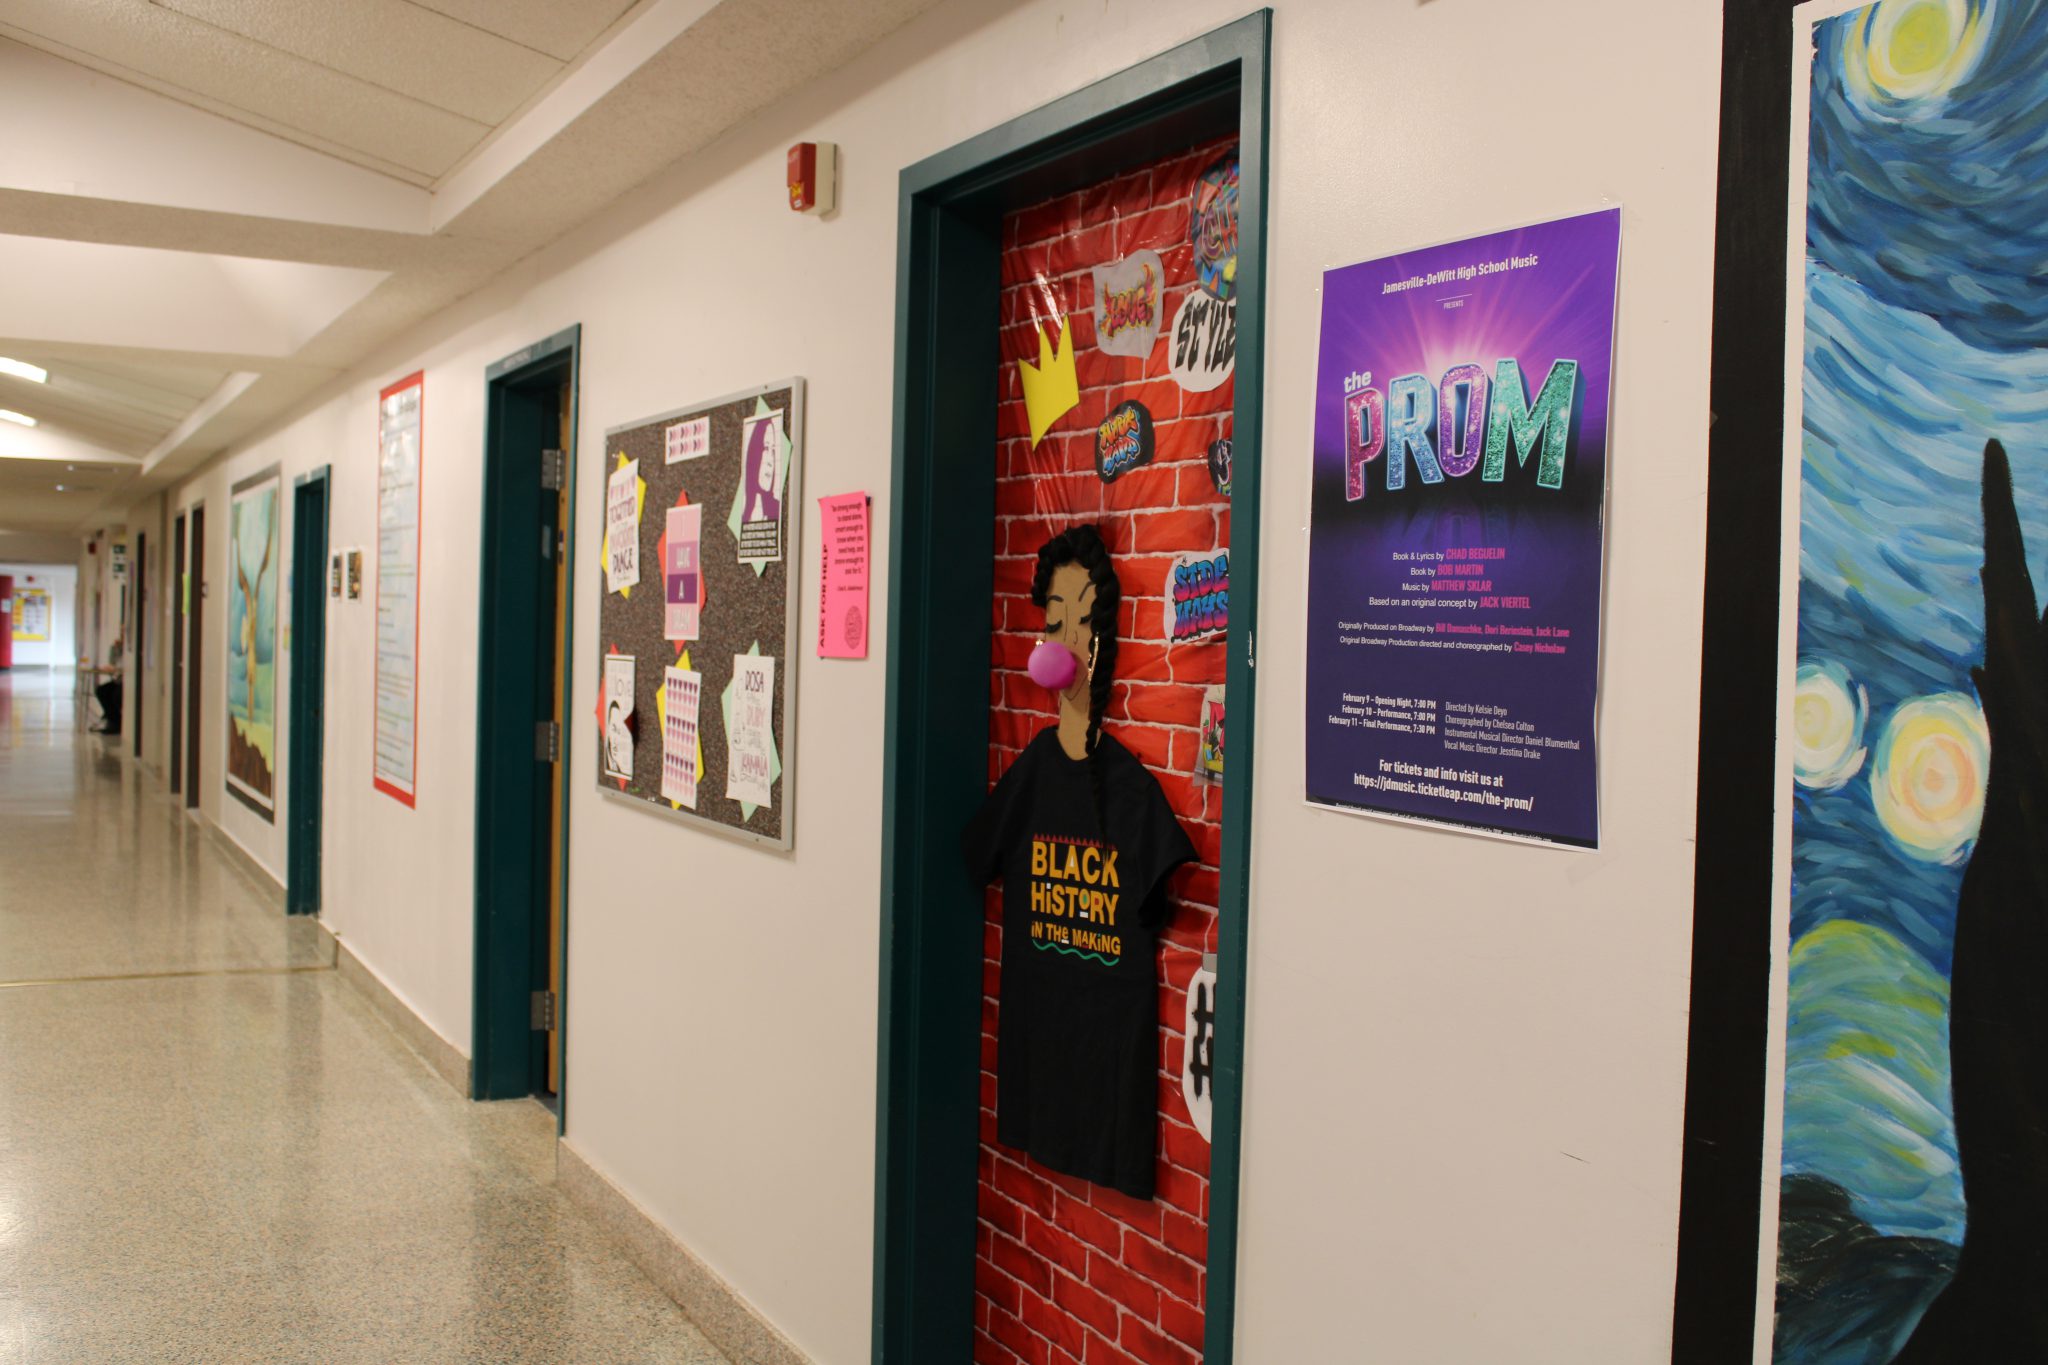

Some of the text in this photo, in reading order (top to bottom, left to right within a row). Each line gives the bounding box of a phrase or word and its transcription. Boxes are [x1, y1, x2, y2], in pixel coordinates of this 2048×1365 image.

[1381, 253, 1539, 295] Jamesville-DeWitt High School Music
[1443, 300, 1464, 310] PRESENTS
[1343, 370, 1372, 394] the
[1344, 358, 1582, 502] PROM
[1393, 552, 1409, 561] Book
[1410, 552, 1415, 560] &
[1416, 552, 1434, 562] Lyrics
[1436, 552, 1444, 562] by
[1446, 548, 1468, 560] CHAD
[1410, 564, 1484, 578] Book by BOB MARTIN
[1402, 580, 1492, 593] Music by MATTHEW SKLAR
[1368, 597, 1389, 606] Based
[1412, 598, 1436, 608] original
[1438, 598, 1467, 609] concept
[1468, 599, 1478, 610] by
[1480, 597, 1499, 609] JACK
[1500, 597, 1531, 609] VIERTEL
[1338, 621, 1362, 632] Originally
[1364, 622, 1389, 631] Produced
[1398, 624, 1426, 634] Broadway
[1426, 624, 1434, 634] by
[1340, 636, 1360, 646] Original
[1361, 636, 1388, 647] Broadway
[1388, 638, 1418, 647] Production
[1419, 639, 1442, 648] directed
[1443, 641, 1454, 649] and
[1456, 642, 1503, 652] choreographed
[1504, 644, 1513, 653] by
[1342, 692, 1366, 705] February
[1366, 695, 1370, 703] 9
[1375, 696, 1396, 708] Opening
[1396, 698, 1413, 708] Night,
[1414, 699, 1426, 708] 7:00
[1427, 700, 1436, 710] PM
[1446, 702, 1508, 718] Directed by Kelsie Deyo
[1342, 704, 1364, 717] February
[1366, 707, 1372, 716] 10
[1377, 708, 1412, 721] Performance,
[1414, 712, 1426, 722] 7:00
[1426, 712, 1436, 722] PM
[1328, 715, 1351, 728] February
[1352, 718, 1358, 726] 11
[1363, 718, 1376, 729] Final
[1377, 720, 1412, 734] Performance,
[1413, 724, 1426, 734] 7:30
[1426, 725, 1436, 735] PM
[1445, 714, 1534, 732] Choreographed by Chelsea Colton
[1444, 727, 1580, 750] Instrumental Musical Director Daniel Blumenthal
[1444, 740, 1459, 750] Vocal
[1460, 742, 1475, 752] Music
[1476, 743, 1498, 755] Director
[1524, 748, 1541, 760] Drake
[1379, 759, 1504, 788] For tickets and info visit us at
[1353, 773, 1534, 812] https://jdmusic.ticketleap.com/the-prom/
[1031, 841, 1120, 888] BLACK
